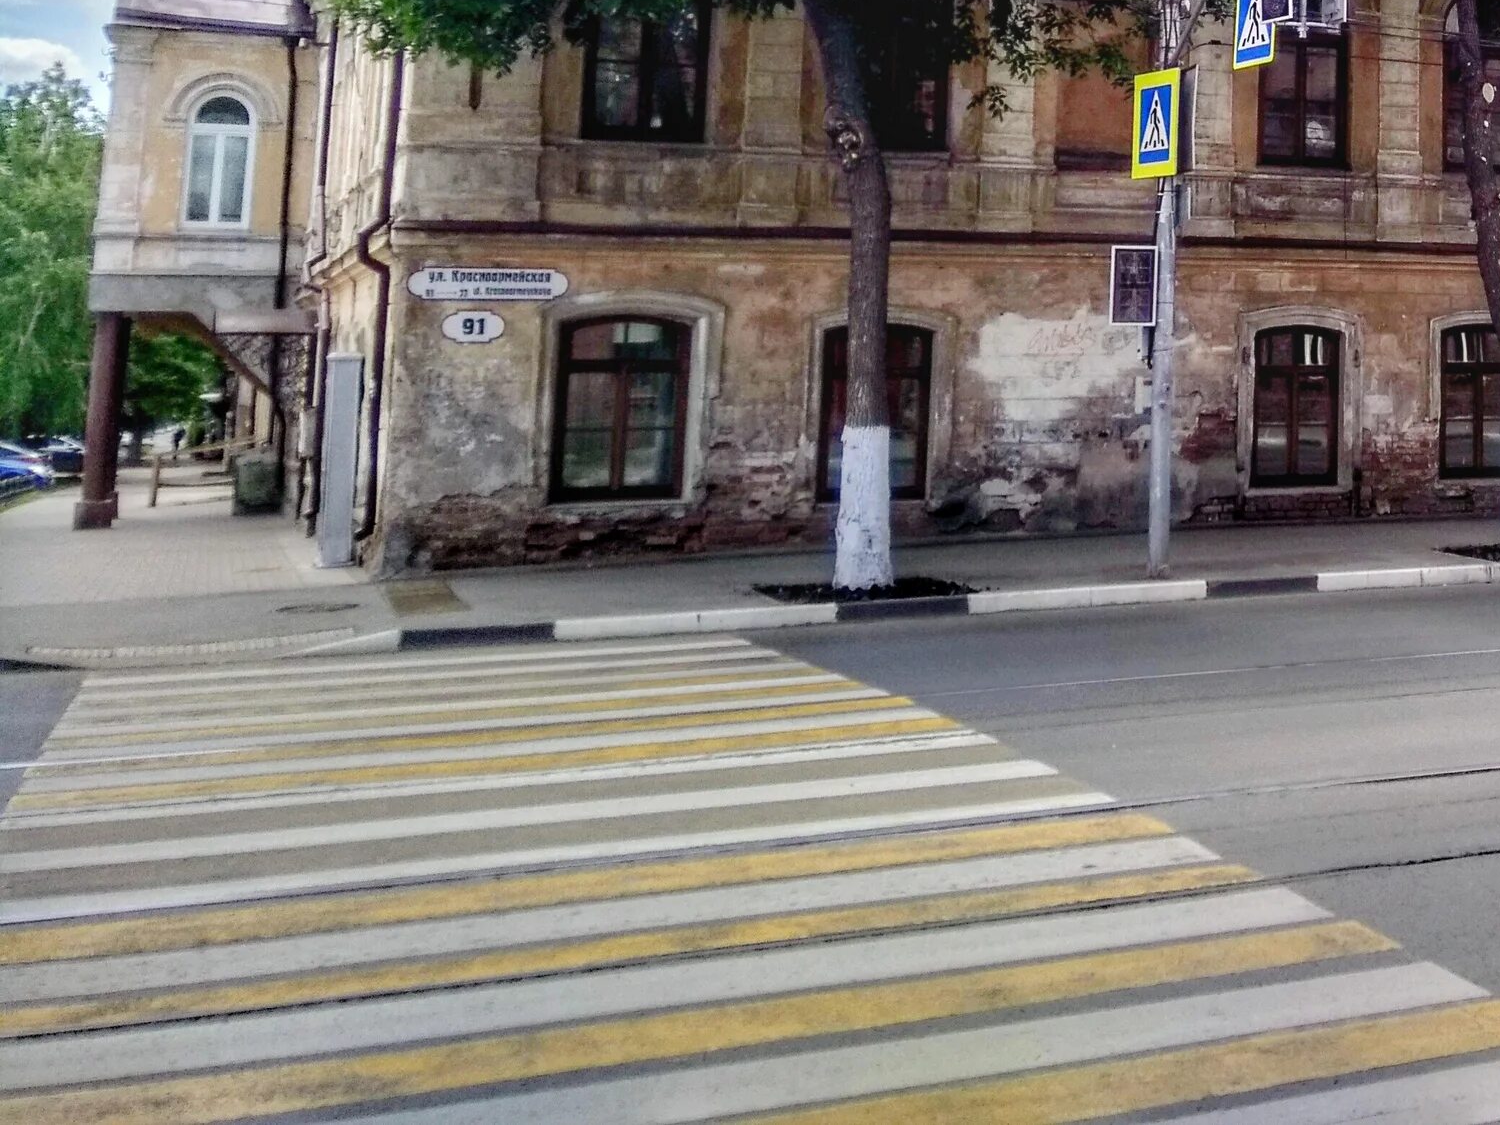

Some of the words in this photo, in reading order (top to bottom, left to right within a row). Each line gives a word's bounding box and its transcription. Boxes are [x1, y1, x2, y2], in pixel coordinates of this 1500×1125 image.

[428, 271, 446, 283] ул.
[451, 270, 551, 283] Красноармейская
[462, 318, 485, 335] 91
